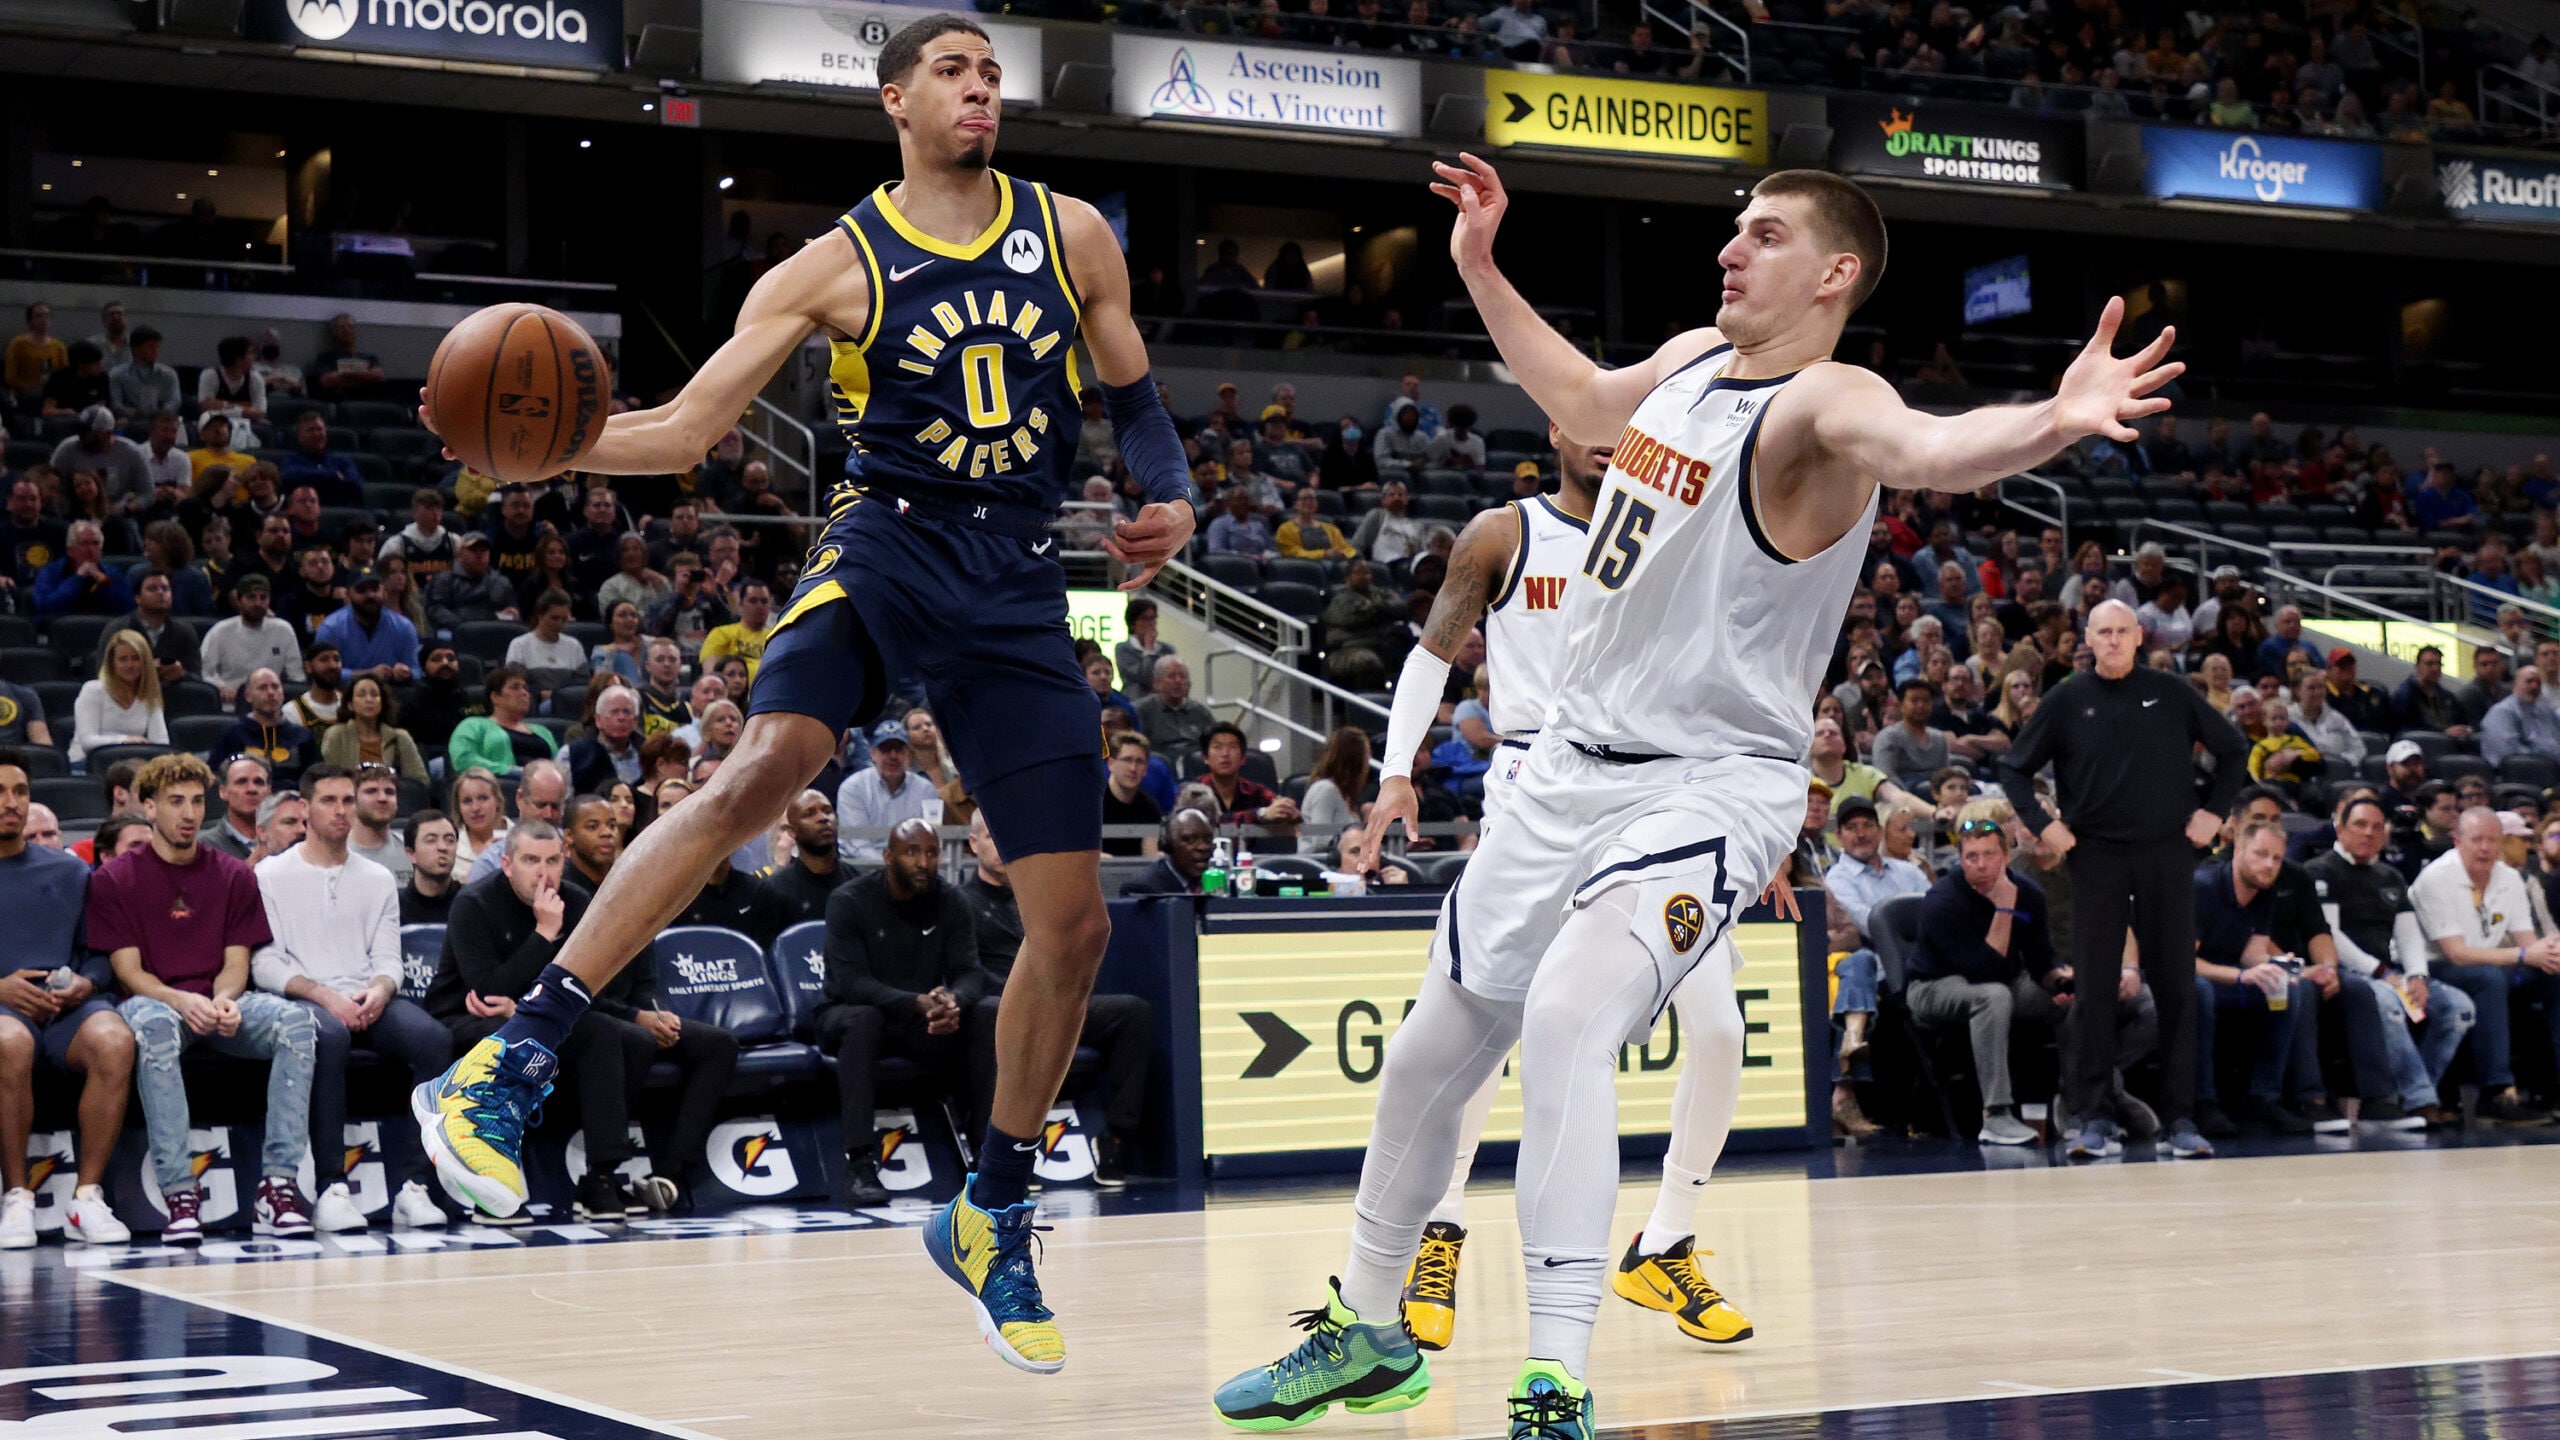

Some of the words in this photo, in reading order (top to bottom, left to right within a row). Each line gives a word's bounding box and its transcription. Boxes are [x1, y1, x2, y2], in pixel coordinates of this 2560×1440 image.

[368, 0, 588, 43] motorola
[821, 52, 877, 71] BENT
[1228, 51, 1380, 89] Ascension
[667, 99, 695, 122] EXIT
[1228, 88, 1265, 118] St.
[1269, 92, 1385, 128] Vincent
[1547, 93, 1753, 145] GAINBRIDGE
[1885, 130, 2041, 163] DRAFTKINGS
[1923, 156, 2041, 184] SPORTSBOOK
[2219, 136, 2308, 203] Kroger
[898, 290, 1061, 375] INDIANA
[962, 343, 1011, 429] 0
[915, 407, 1049, 479] PACERS
[1610, 425, 1712, 506] NUGGETS
[1582, 486, 1659, 592] 15
[668, 986, 693, 995] DAILY
[693, 983, 730, 994] FANTASY
[731, 977, 765, 991] SPORTS
[678, 958, 737, 977] DRAFT
[689, 970, 739, 985] KINGS
[706, 1114, 799, 1196] G
[64, 1204, 942, 1268] POINTSBE
